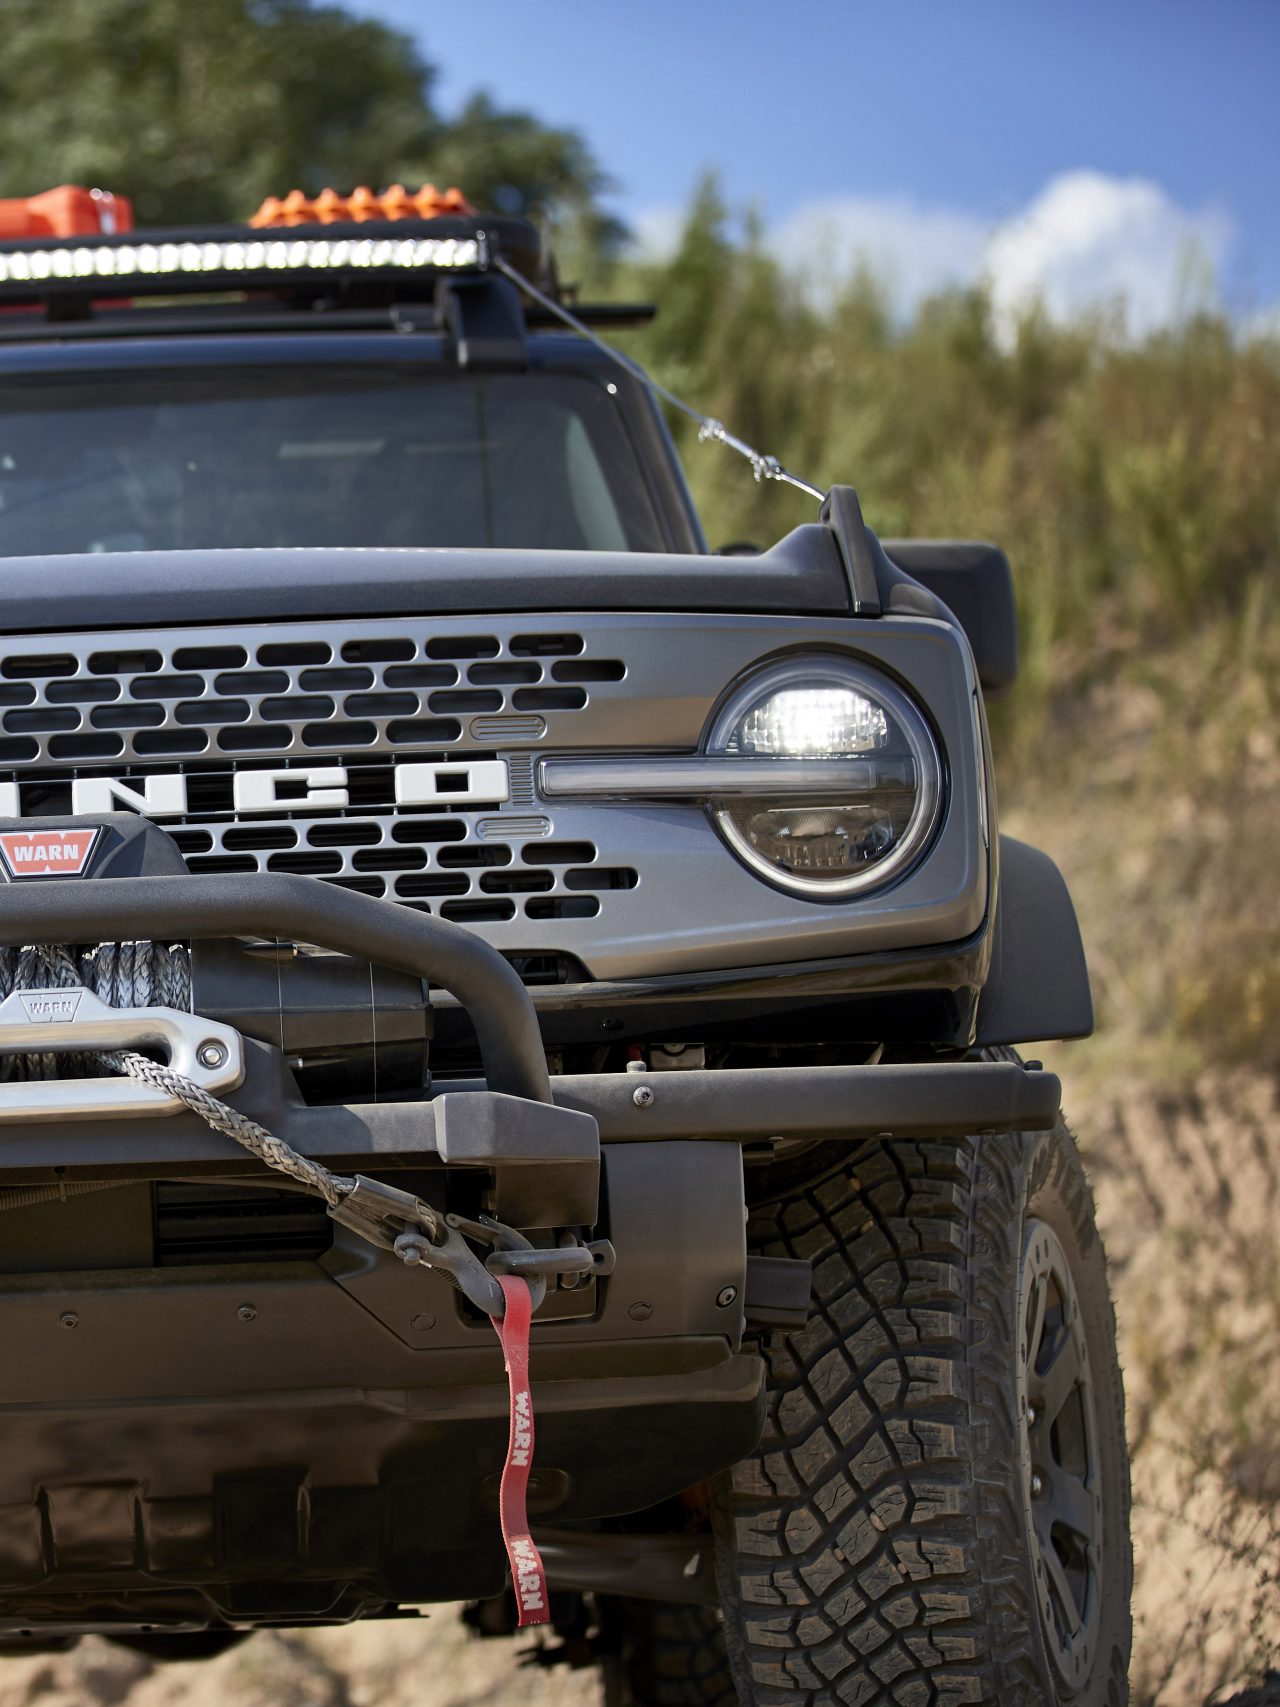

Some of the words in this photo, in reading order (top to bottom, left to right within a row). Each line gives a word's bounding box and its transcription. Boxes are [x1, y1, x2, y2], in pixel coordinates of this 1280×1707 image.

[13, 844, 79, 863] WARN
[29, 1001, 73, 1014] WARN
[510, 1391, 531, 1467] WARN
[510, 1538, 544, 1612] WARN
